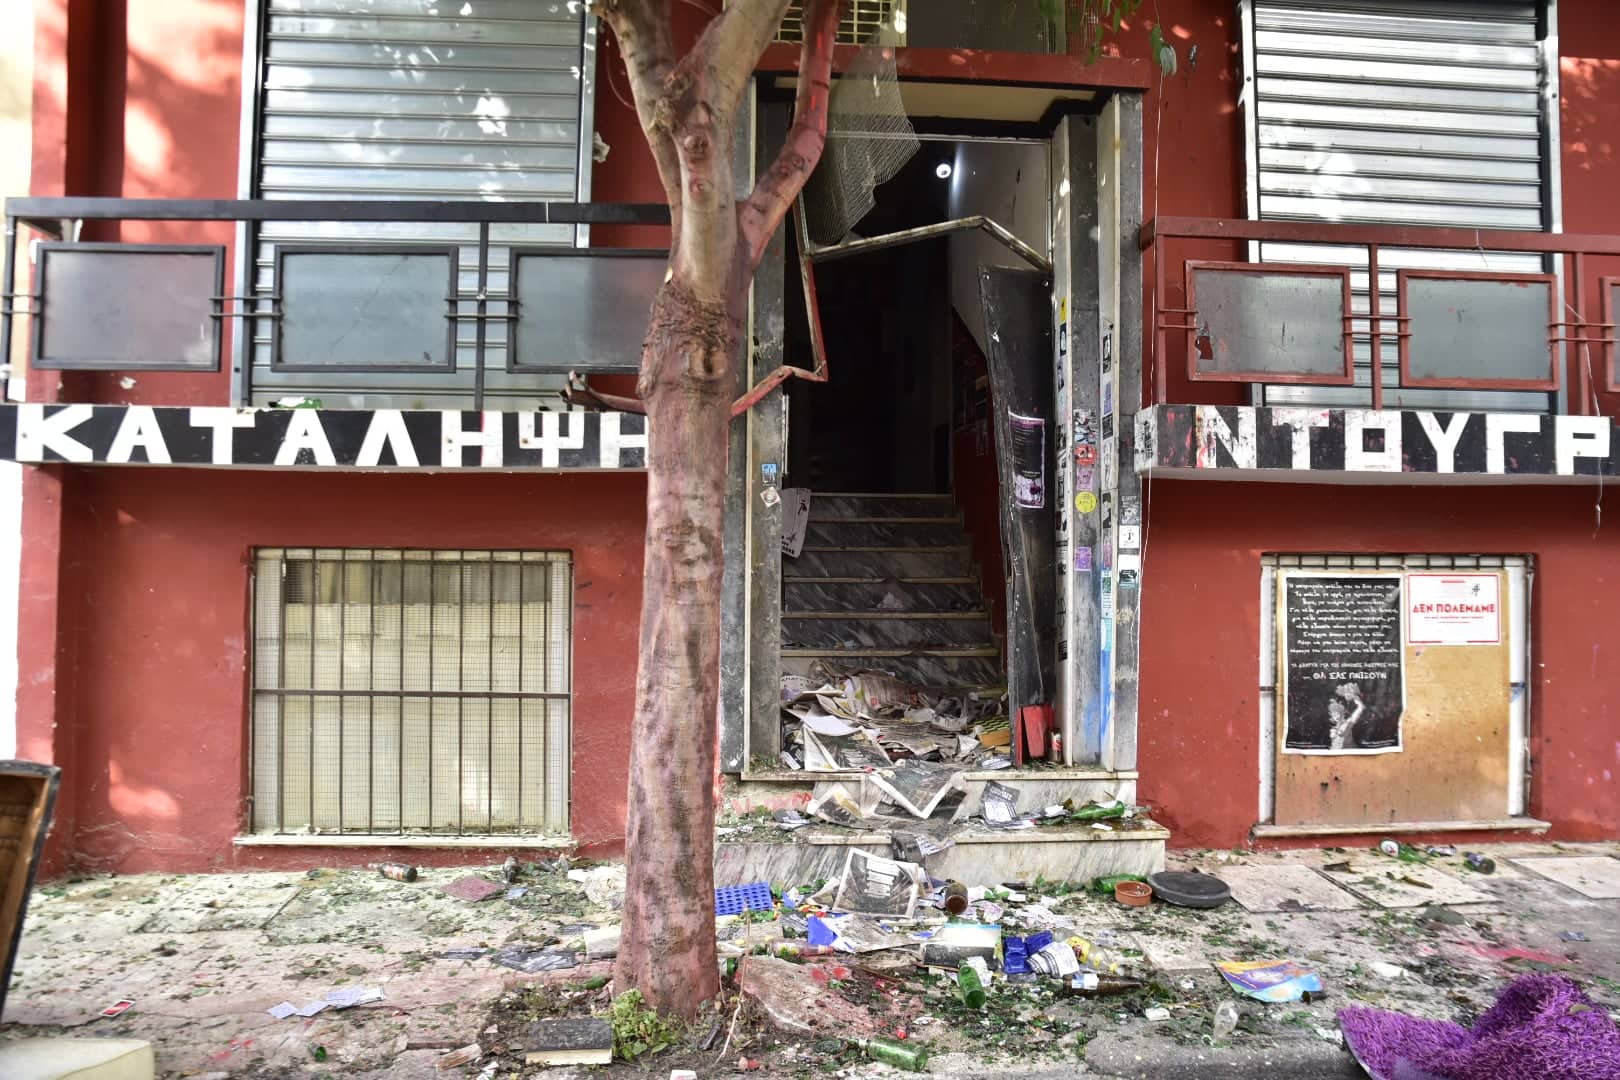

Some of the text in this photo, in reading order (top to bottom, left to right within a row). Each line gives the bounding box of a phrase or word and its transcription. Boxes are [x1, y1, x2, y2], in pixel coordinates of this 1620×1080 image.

[16, 404, 649, 468] ΚΑΤΑΛΗΨΗ
[1412, 603, 1496, 613] ΔΕΝ ΠΟΛΕΜΑΜΕ
